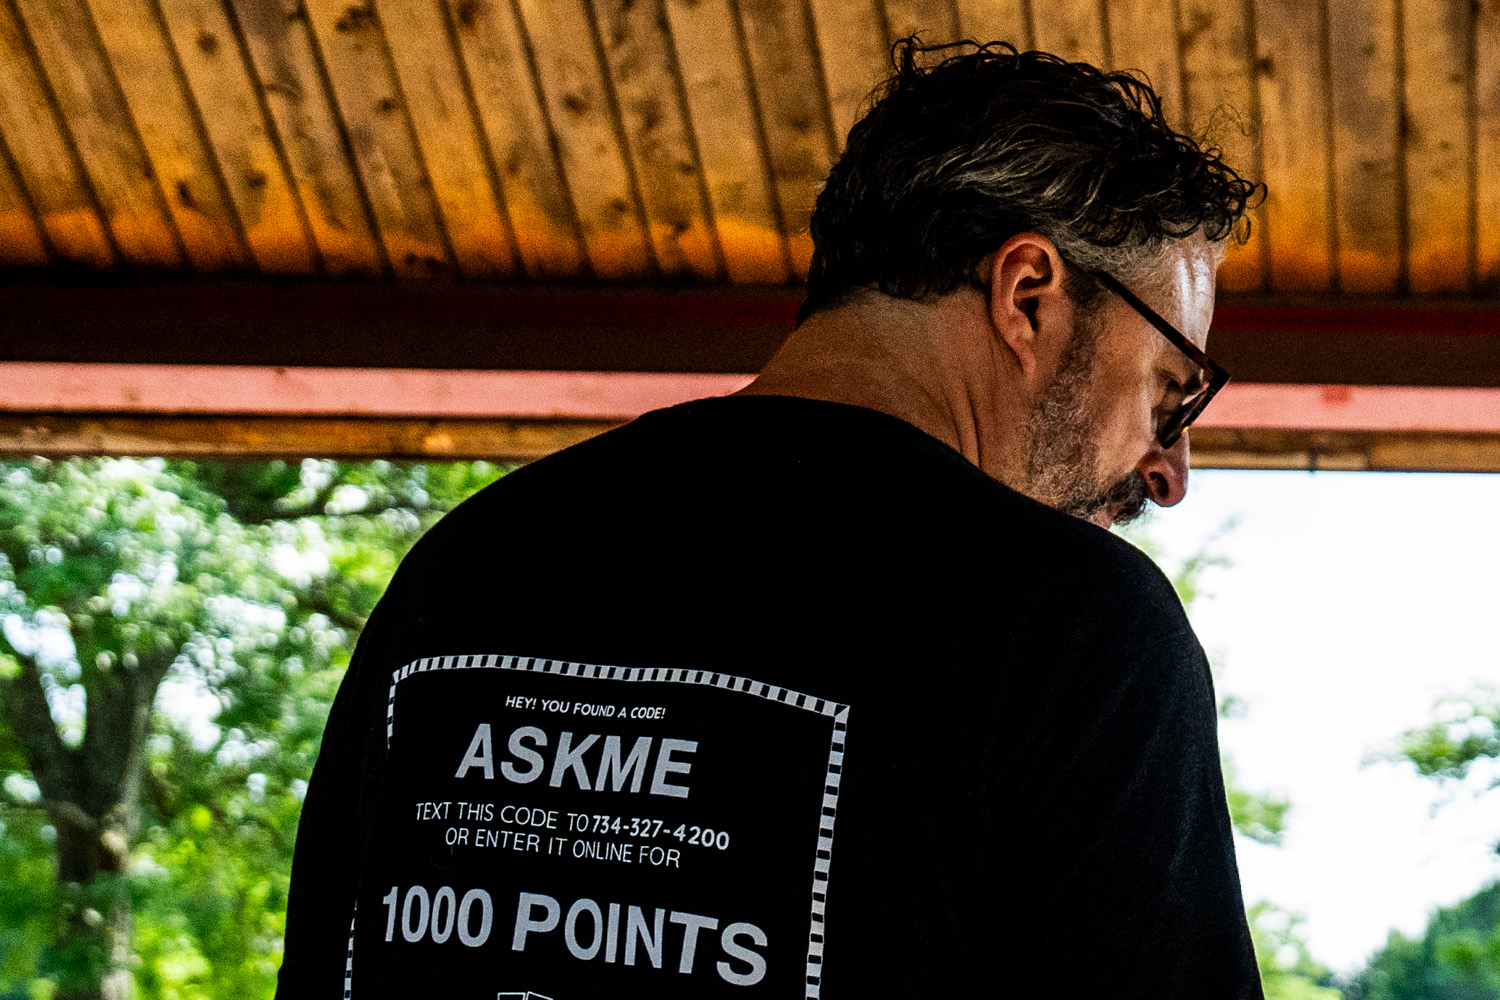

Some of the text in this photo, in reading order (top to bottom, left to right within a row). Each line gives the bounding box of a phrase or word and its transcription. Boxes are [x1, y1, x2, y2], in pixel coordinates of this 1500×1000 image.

[505, 695, 666, 720] HEY! YOU FOUND A CODE!
[455, 723, 699, 799] ASKME
[416, 801, 730, 851] TEXT THIS CODE TO 734-327-4200
[445, 827, 681, 869] OR ENTER IT ONLINE FOR
[382, 885, 768, 987] 1000 POINTS
